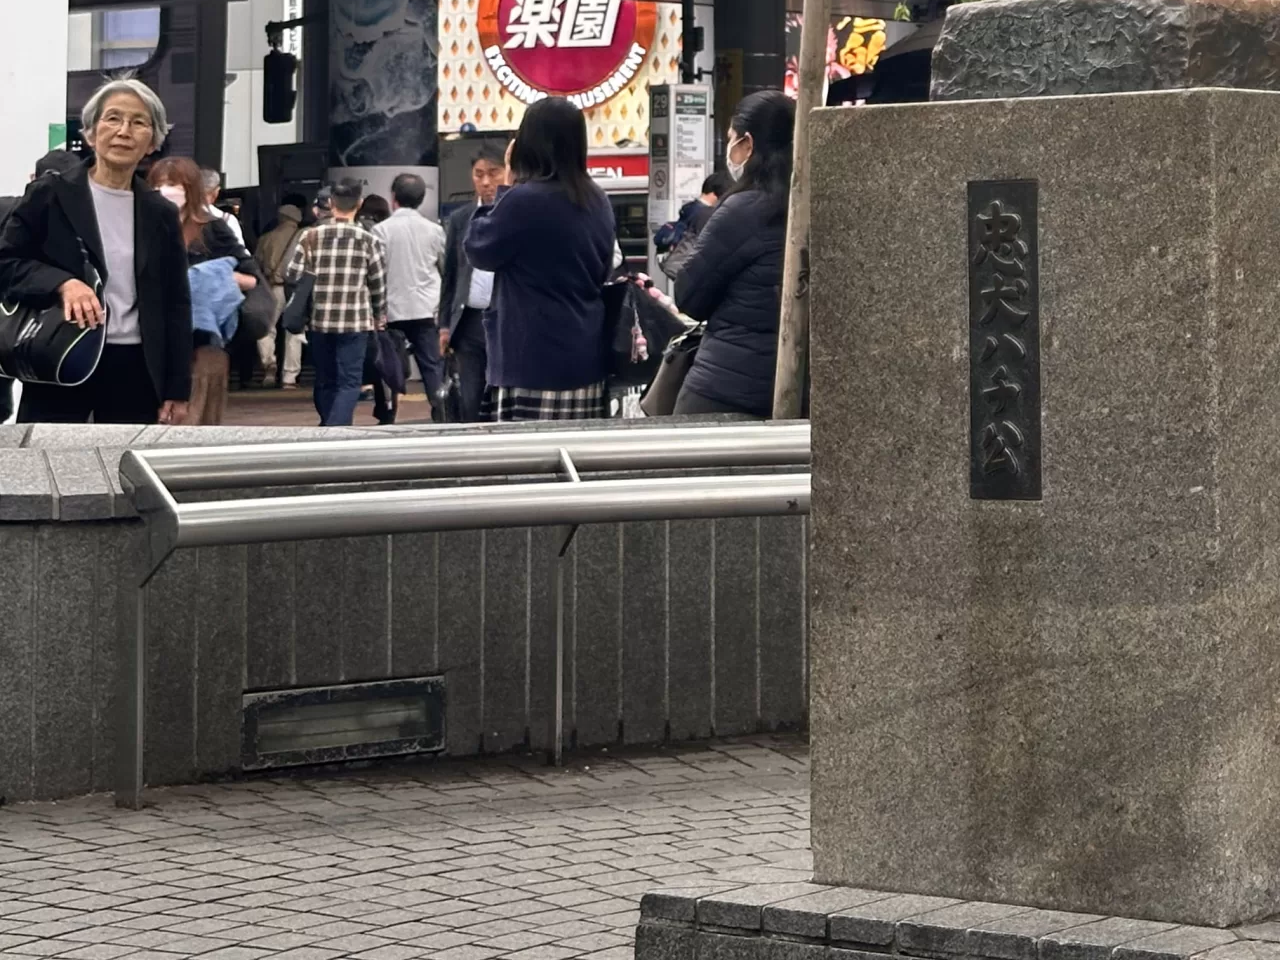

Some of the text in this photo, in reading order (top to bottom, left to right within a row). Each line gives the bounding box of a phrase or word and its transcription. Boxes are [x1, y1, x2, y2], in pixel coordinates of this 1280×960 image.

[567, 42, 646, 109] MUSEMENT
[654, 94, 667, 109] 29
[972, 200, 1030, 475] 忠犬ハチ公
